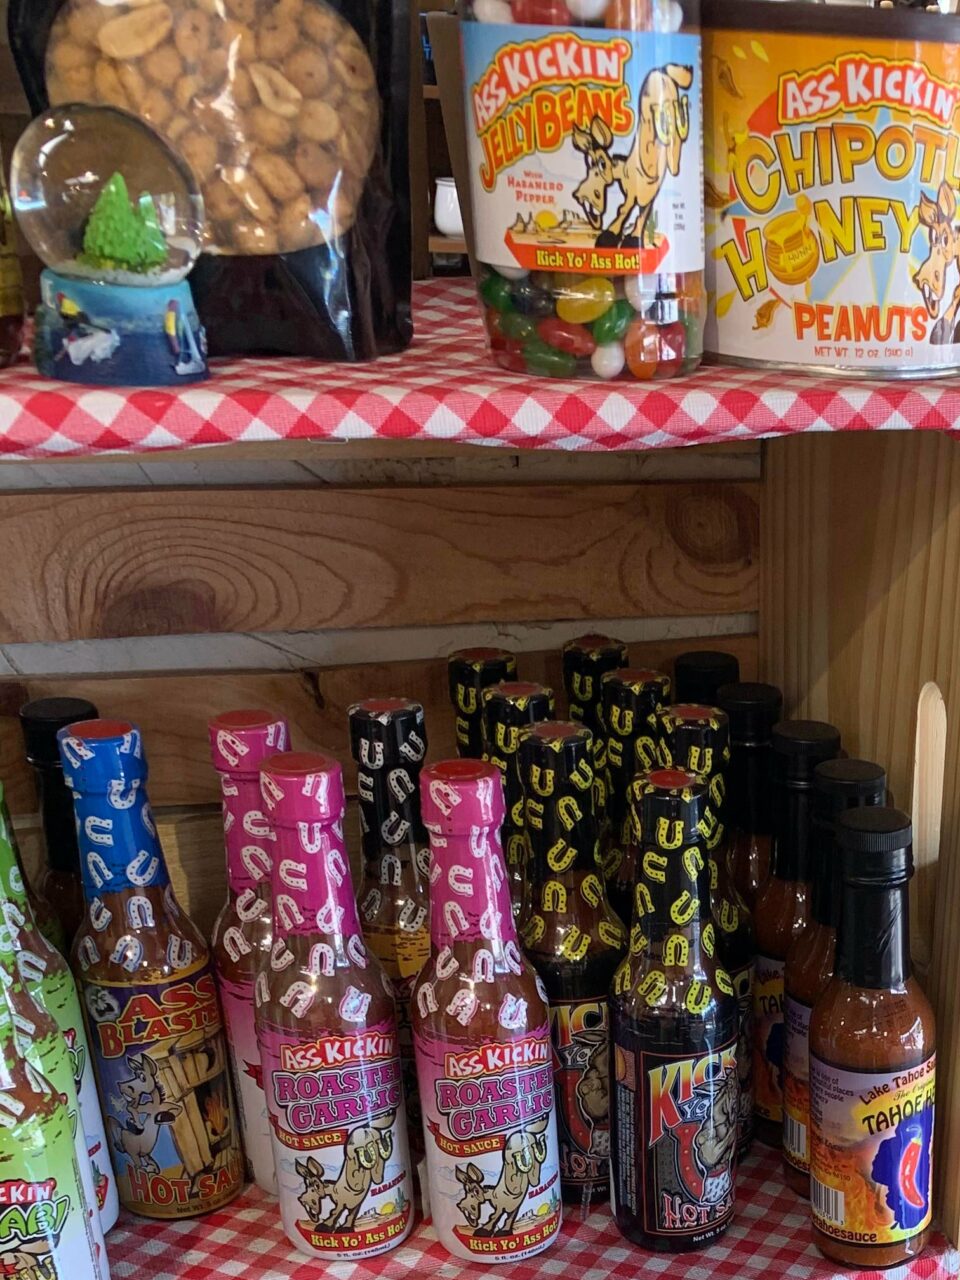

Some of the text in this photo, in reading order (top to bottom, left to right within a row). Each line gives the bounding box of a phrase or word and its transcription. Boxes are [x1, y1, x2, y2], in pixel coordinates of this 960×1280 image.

[474, 36, 627, 130] ASS KICKIN'
[783, 61, 960, 120] ASS KICKIN'
[481, 89, 633, 190] JELLY BEANS
[515, 190, 555, 203] PEPPER
[537, 251, 640, 269] Kick Yo' Ass Hot!
[794, 302, 928, 342] PEANUTS
[815, 346, 864, 357] NET 12
[117, 974, 218, 1024] ASS
[97, 1002, 222, 1059] BLASTE
[285, 1049, 323, 1070] ASS
[449, 1054, 485, 1076] ASS
[276, 1063, 402, 1101] ROASTE
[439, 1067, 553, 1108] ROASTE
[859, 1066, 924, 1105] Lake Tahoe
[862, 1094, 922, 1135] TAHOE
[279, 1130, 342, 1148] HOT SAUCE
[440, 1138, 501, 1154] HOT SAUCE
[126, 1164, 191, 1204] HOT
[663, 1193, 709, 1229] HOT
[311, 1219, 406, 1248] Kick Ass Hot!
[468, 1232, 542, 1252] Kick Ass
